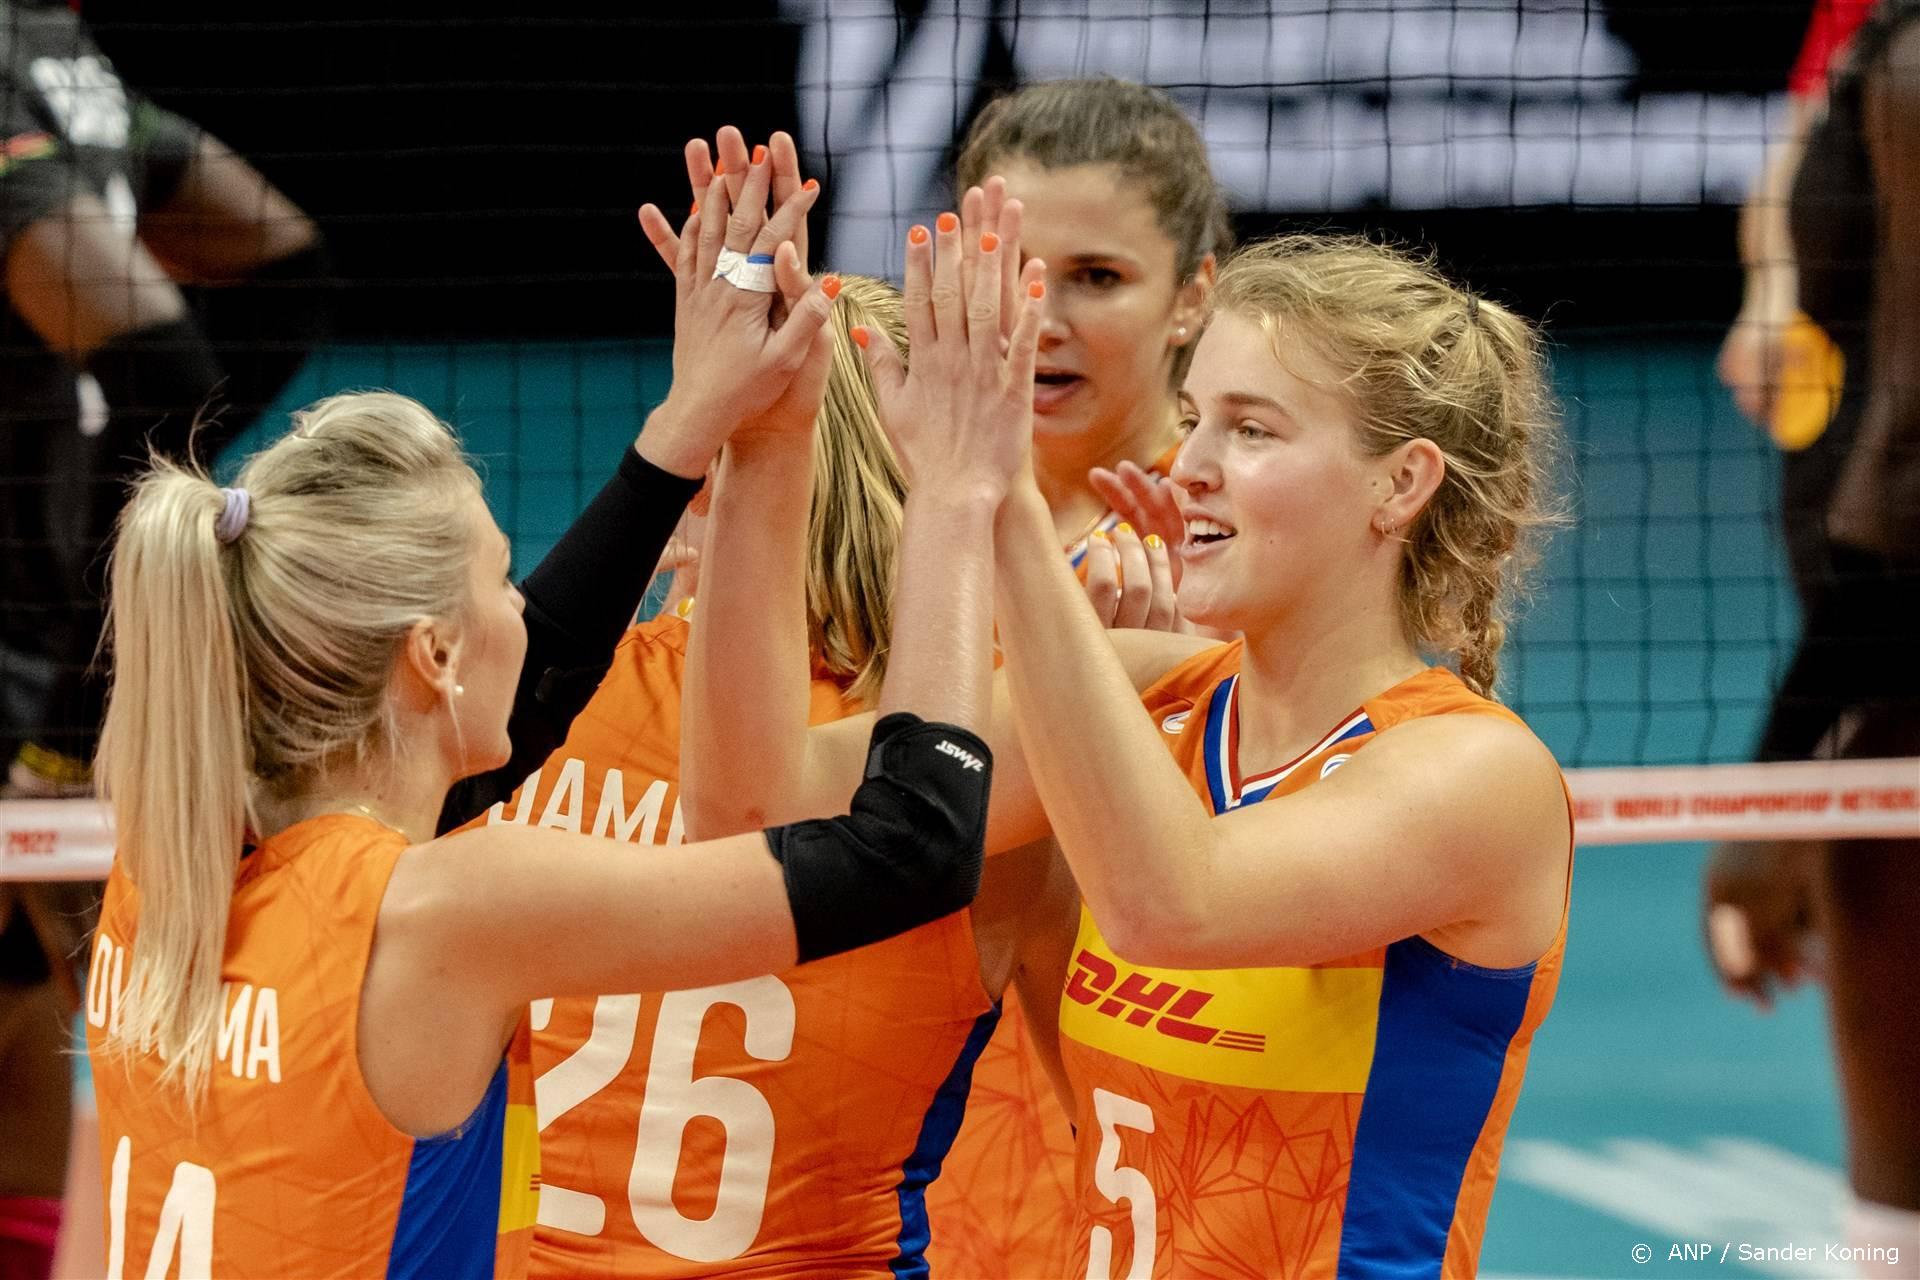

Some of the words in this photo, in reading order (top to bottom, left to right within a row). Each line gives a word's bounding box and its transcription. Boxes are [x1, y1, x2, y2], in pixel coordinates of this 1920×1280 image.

[1065, 949, 1220, 1045] DHL
[530, 974, 796, 1262] 26
[1085, 1087, 1156, 1280] 5
